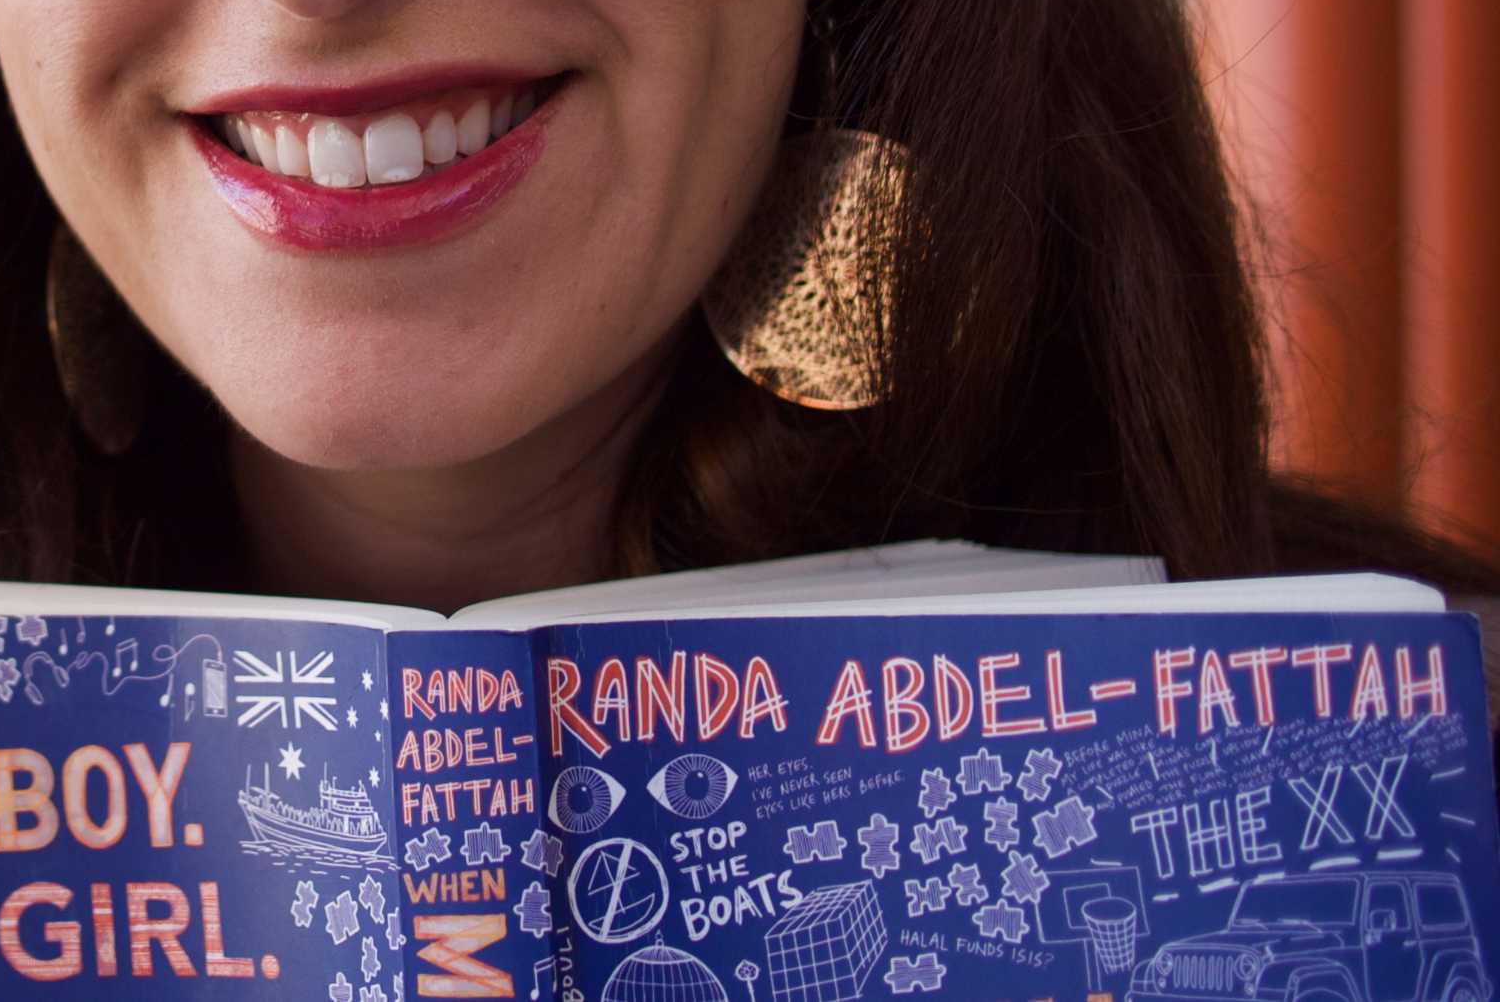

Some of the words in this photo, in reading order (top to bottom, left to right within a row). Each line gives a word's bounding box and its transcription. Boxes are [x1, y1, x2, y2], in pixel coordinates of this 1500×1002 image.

[402, 666, 523, 721] RANDA
[548, 651, 790, 759] RANDA
[396, 727, 533, 773] ABDEL-
[748, 763, 772, 782] HER
[777, 757, 813, 774] EYES.
[1057, 771, 1077, 787] MY
[1081, 759, 1103, 775] LIFE
[1107, 749, 1127, 763] WAS
[1130, 738, 1155, 754] LIKE
[1064, 740, 1112, 768] BEFORE
[752, 786, 773, 801] I'VE
[780, 775, 820, 795] NEVER
[823, 766, 852, 784] SEEN
[1073, 759, 1138, 790] COMPLETED
[402, 778, 534, 827] FATTAH
[756, 800, 785, 819] EYES
[790, 793, 817, 810] LIKE
[822, 785, 852, 805] HERS
[1131, 787, 1283, 879] THE
[1288, 754, 1416, 851] XX
[670, 821, 747, 863] STOP
[403, 868, 506, 904] WHEN
[679, 854, 749, 893] THE
[680, 869, 803, 941] BOATS
[900, 929, 948, 951] HALAL
[956, 937, 1004, 958] FUNDS
[1011, 947, 1055, 968] ISIS?
